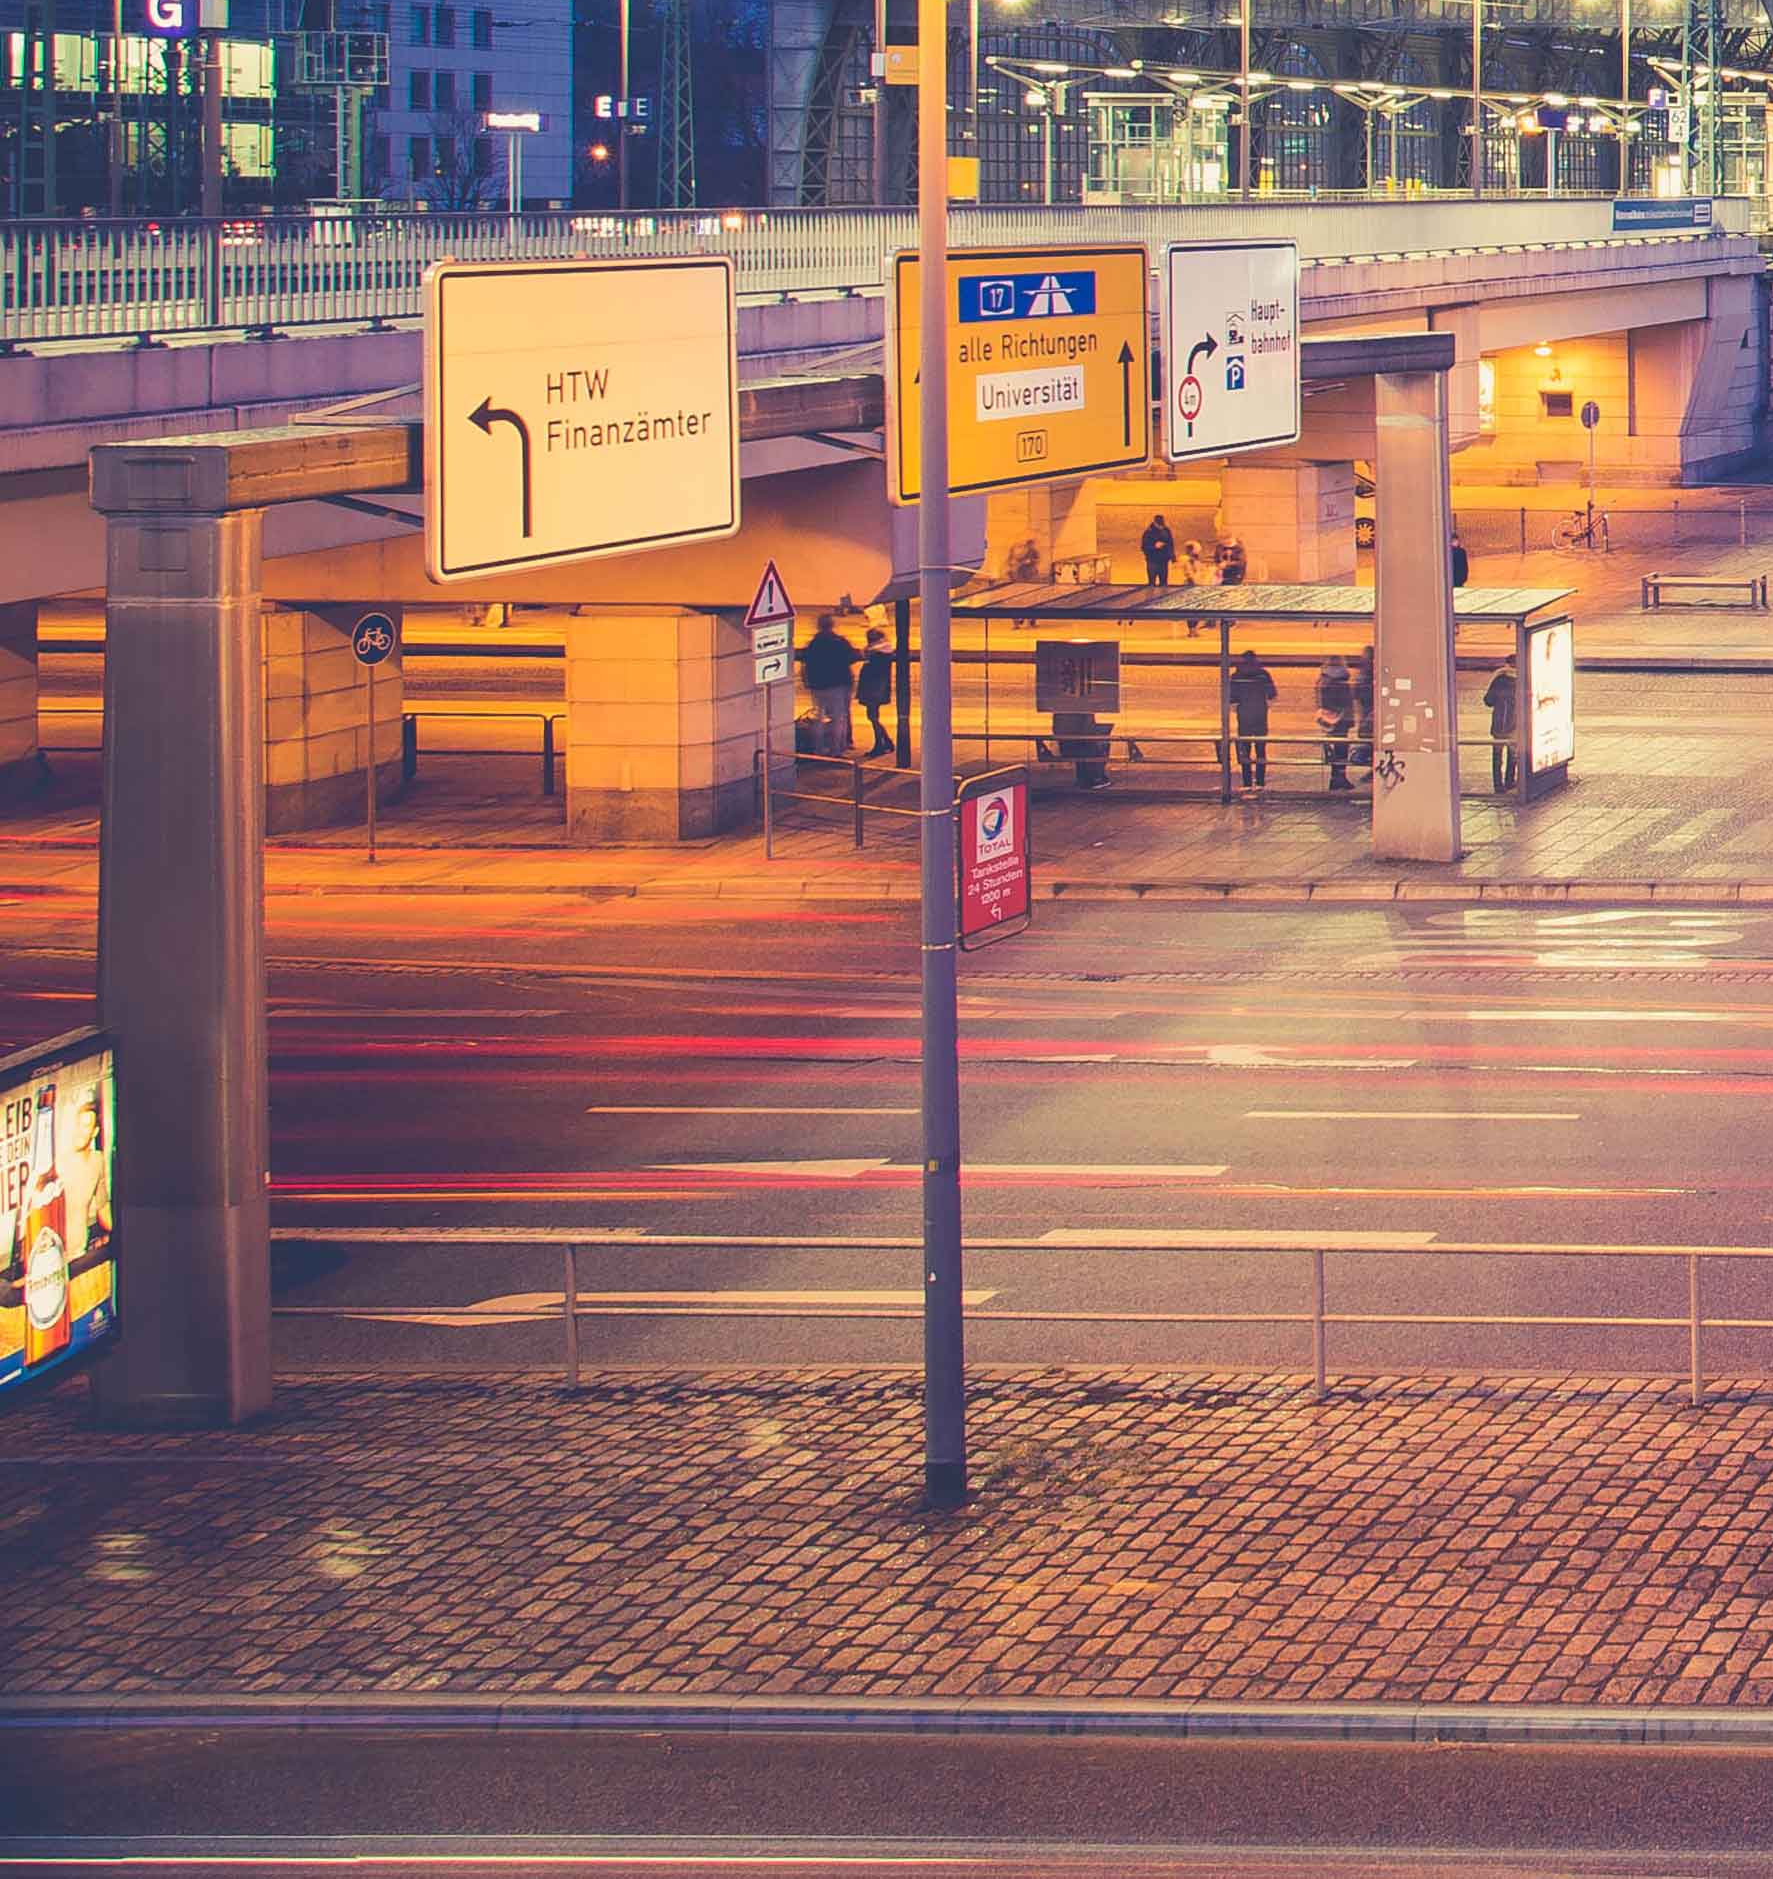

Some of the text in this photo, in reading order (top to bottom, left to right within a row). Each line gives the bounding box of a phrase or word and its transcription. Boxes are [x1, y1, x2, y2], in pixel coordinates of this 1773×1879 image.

[595, 95, 612, 117] E
[636, 97, 649, 116] E
[989, 287, 1004, 309] 17
[1251, 299, 1286, 325] Haupt-
[959, 330, 1098, 363] alle Richtungen
[1251, 330, 1291, 354] bahnhof
[547, 368, 609, 404] HTW
[981, 377, 1079, 410] Universität
[547, 410, 712, 452] Finanzämter
[1021, 435, 1043, 458] 170
[978, 838, 1011, 854] TOTAL
[970, 856, 1019, 879] Tankstelle
[967, 869, 1023, 896] 24 Stunden
